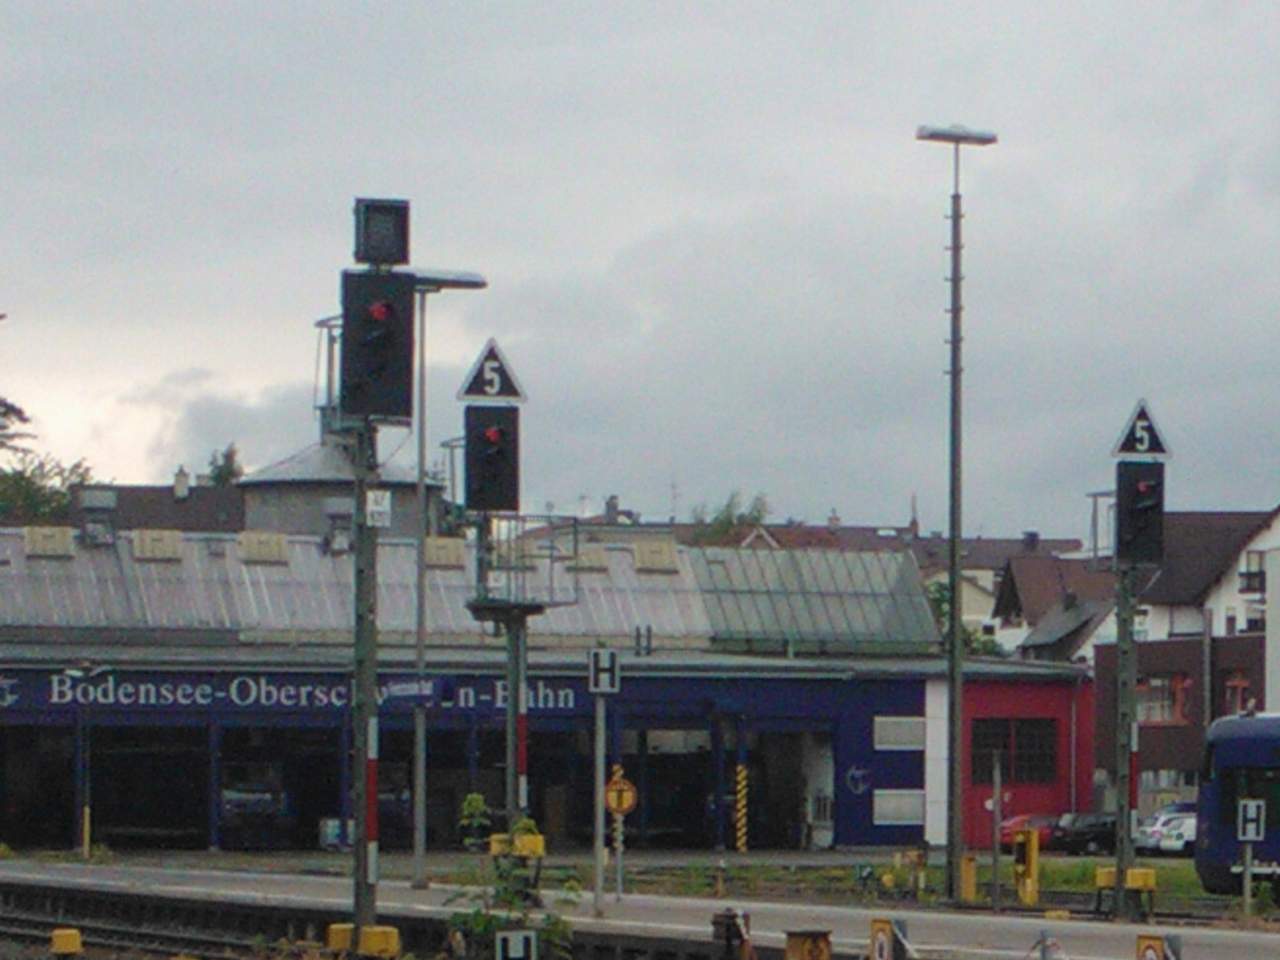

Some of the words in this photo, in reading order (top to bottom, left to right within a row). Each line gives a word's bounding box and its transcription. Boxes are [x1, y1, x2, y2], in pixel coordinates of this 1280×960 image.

[483, 361, 500, 395] 5
[1135, 420, 1149, 451] 5
[593, 651, 616, 689] H
[1242, 803, 1261, 838] H
